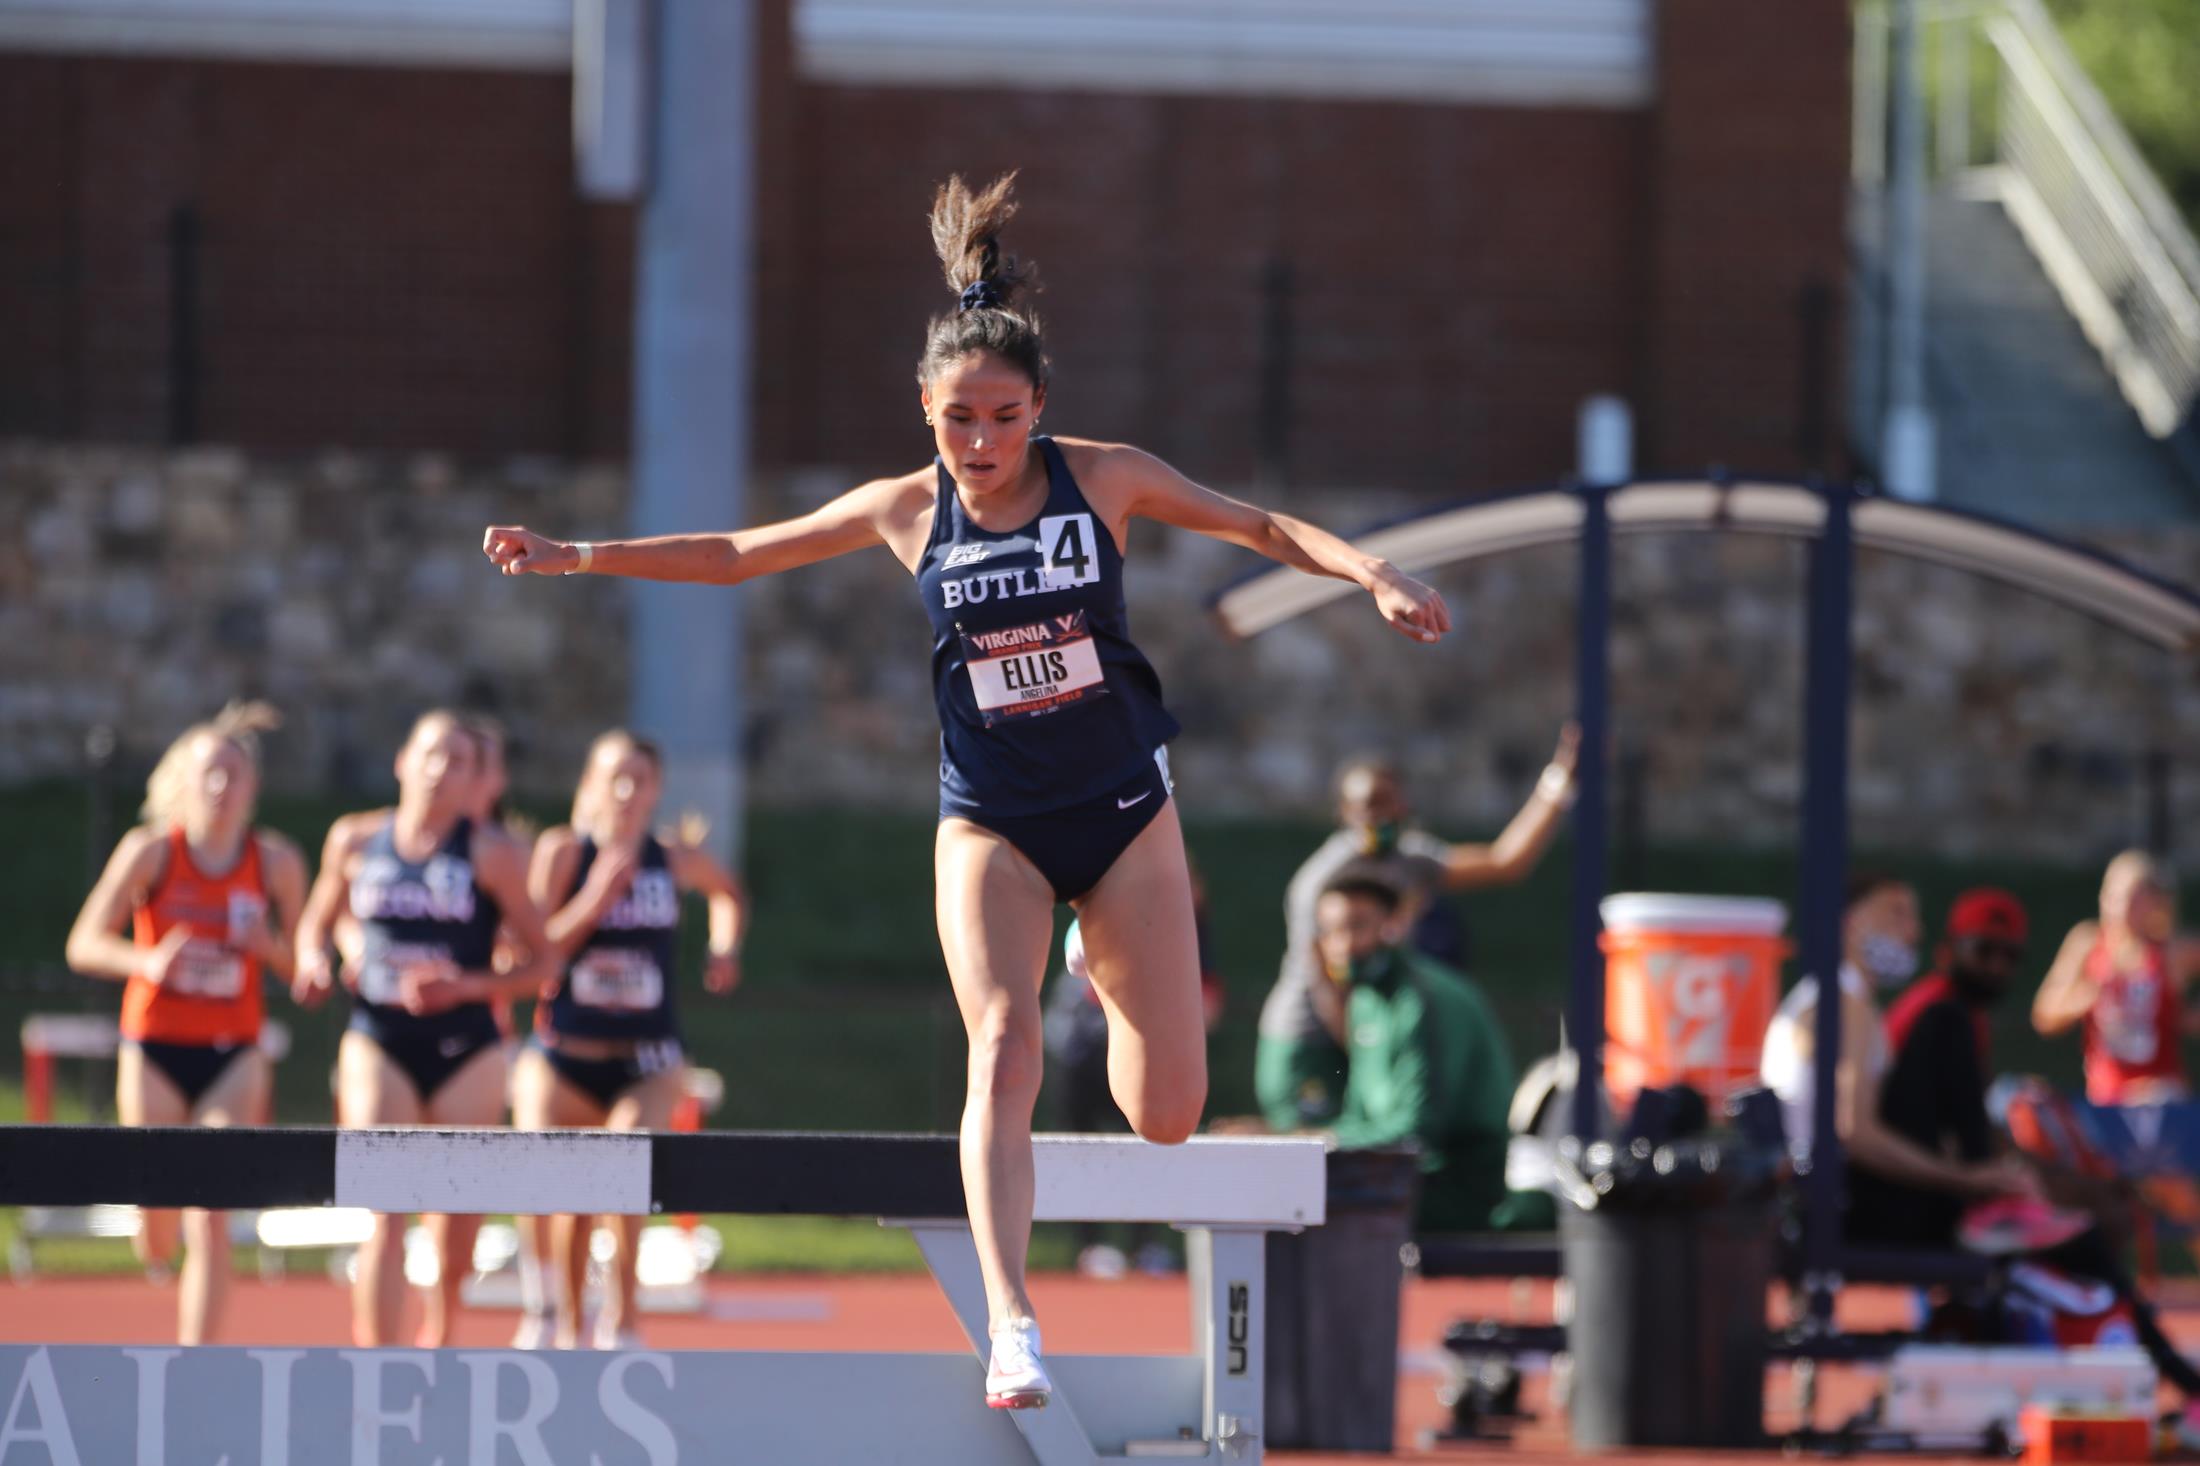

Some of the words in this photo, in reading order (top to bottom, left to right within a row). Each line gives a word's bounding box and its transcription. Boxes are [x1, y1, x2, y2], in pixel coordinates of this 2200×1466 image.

[944, 552, 991, 566] EAST
[952, 543, 984, 555] BIG
[1051, 519, 1090, 579] 4
[941, 567, 1084, 609] BUTLE
[972, 624, 1053, 651] VIRGINIA
[1001, 651, 1068, 691] ELLIS
[1020, 685, 1059, 701] ANGELINA
[1055, 689, 1084, 705] FIELD
[1227, 1284, 1248, 1375] UCS
